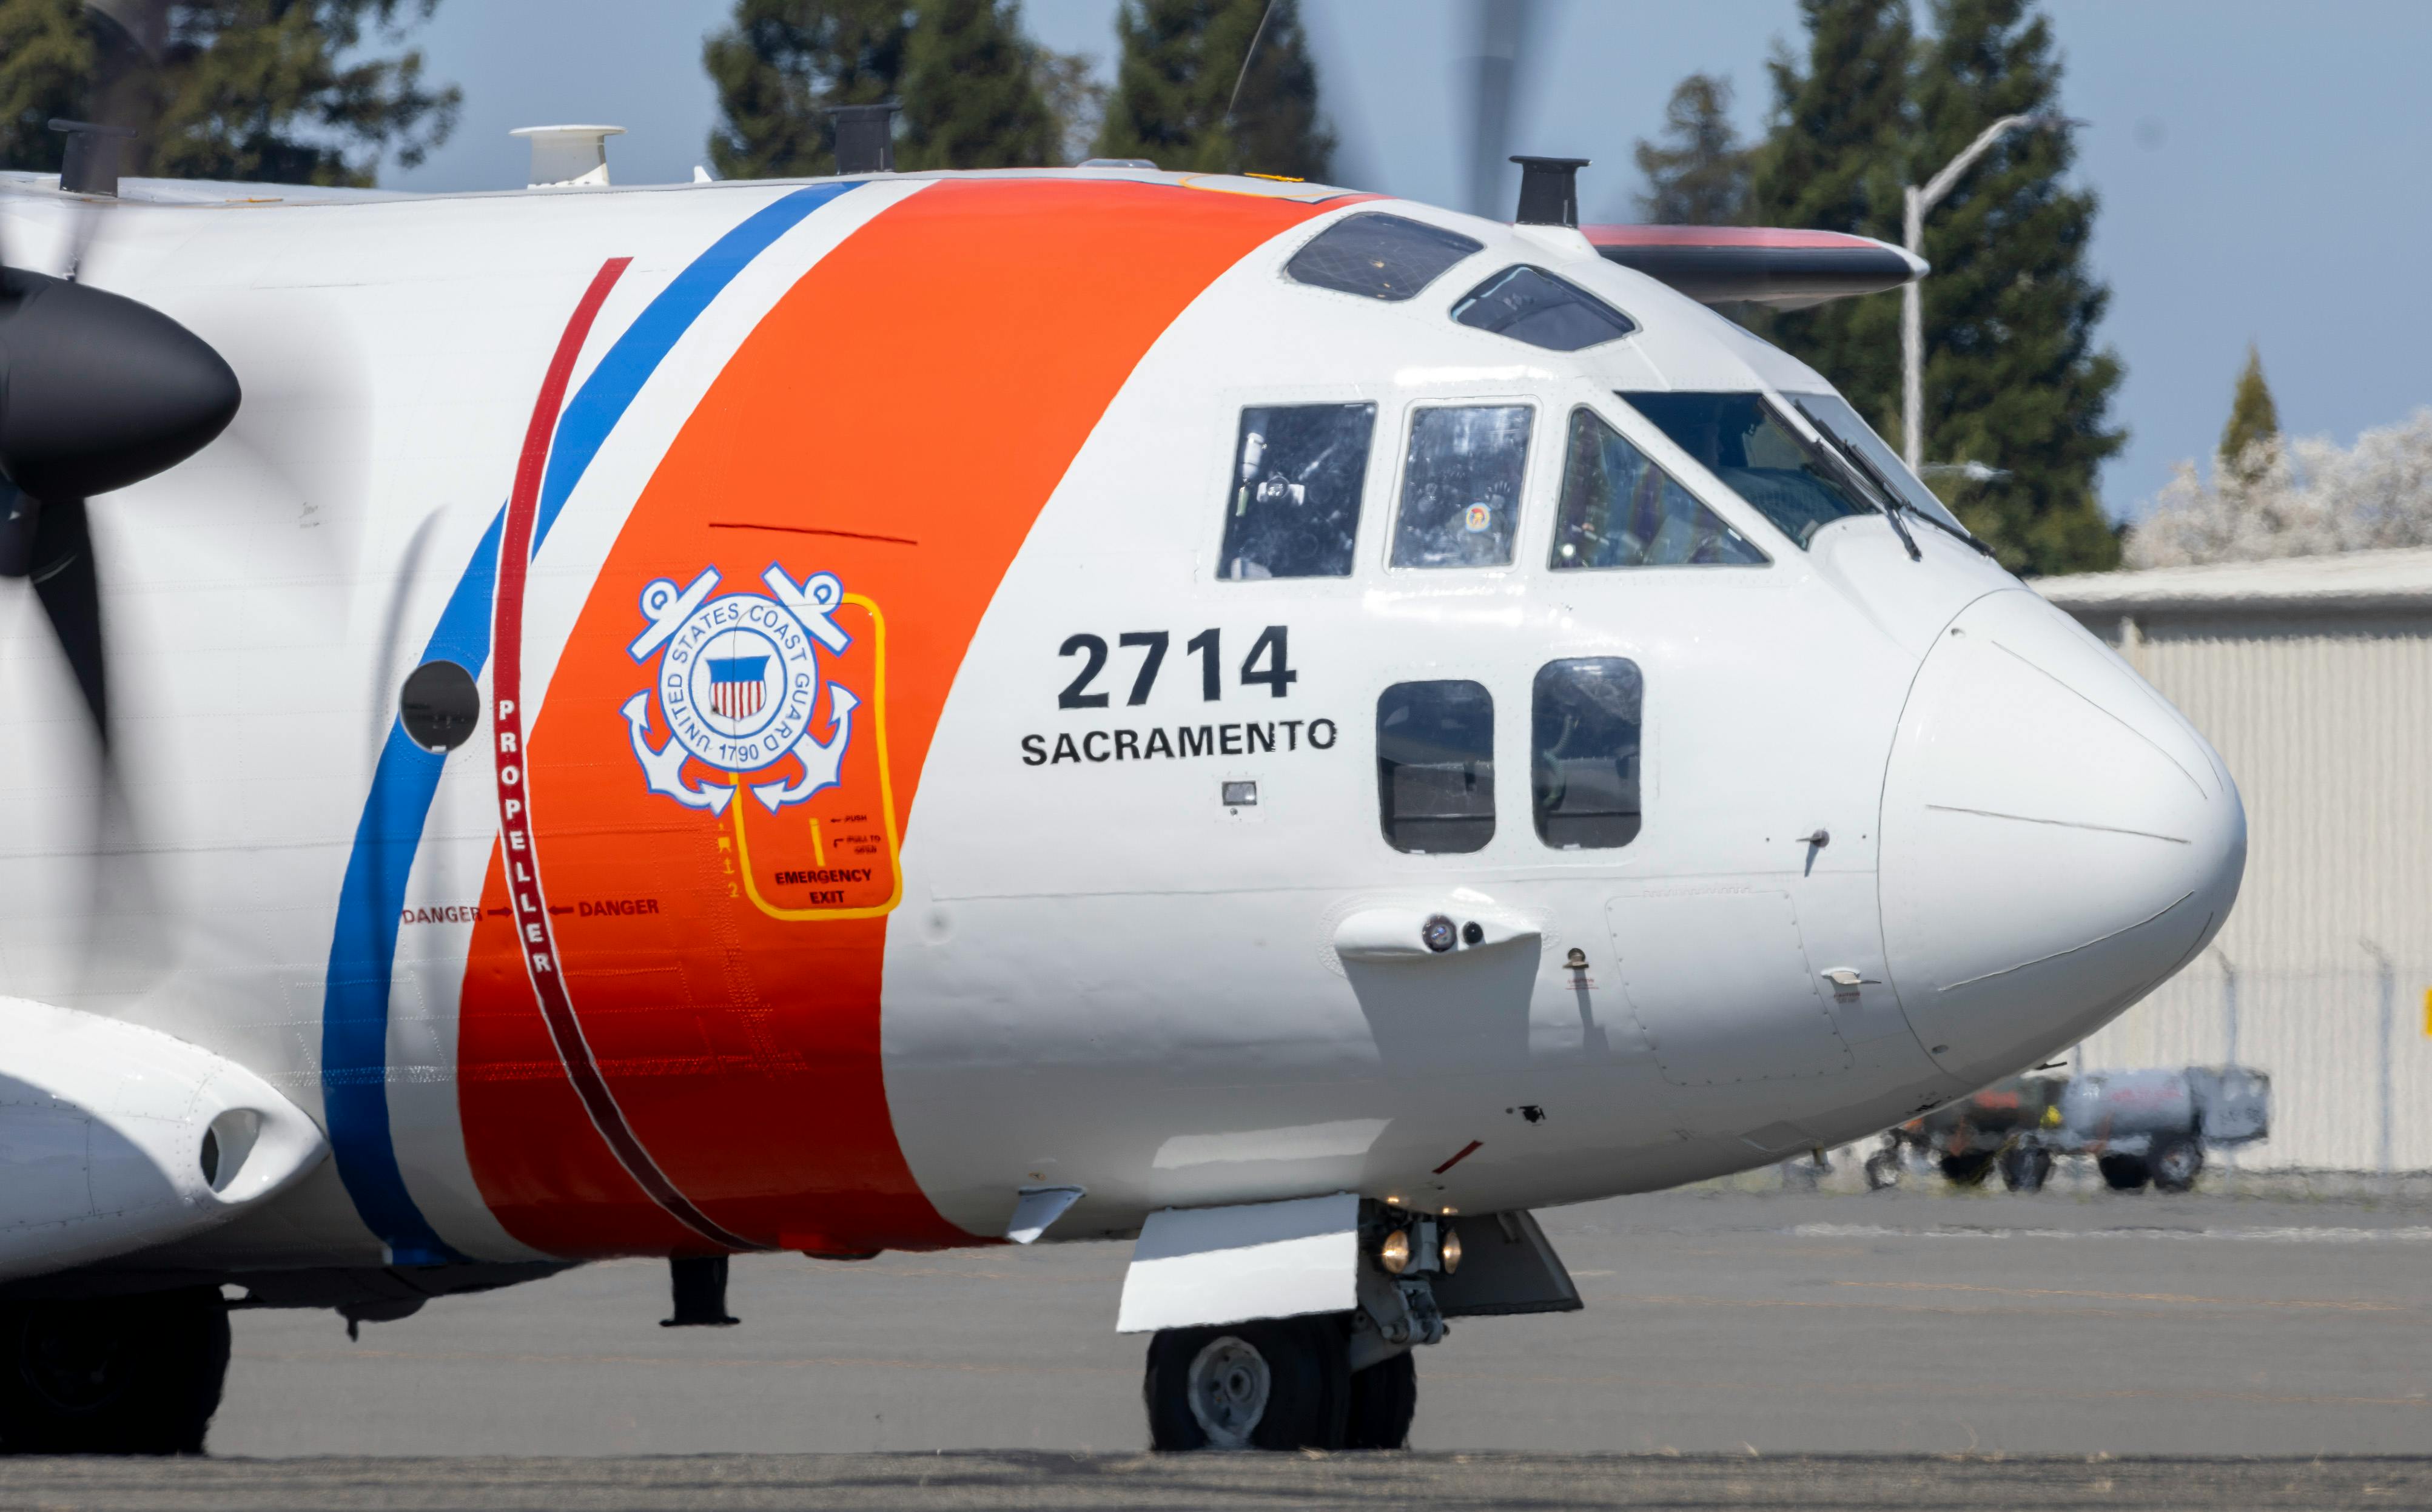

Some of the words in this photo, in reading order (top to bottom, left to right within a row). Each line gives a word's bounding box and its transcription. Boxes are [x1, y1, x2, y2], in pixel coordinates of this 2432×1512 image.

[672, 602, 739, 664] STATES
[750, 605, 807, 662] COAST
[1058, 625, 1297, 710] 2714
[667, 673, 711, 752] UNITED
[763, 672, 810, 751] GUARD
[719, 744, 759, 762] 1790
[1021, 718, 1338, 765] SACRAMENTO
[499, 699, 552, 973] PROPELLER
[774, 869, 872, 885] EMERGENCY
[810, 891, 845, 904] EXIT
[401, 906, 483, 924] DANGER
[578, 899, 659, 917] DANGER
